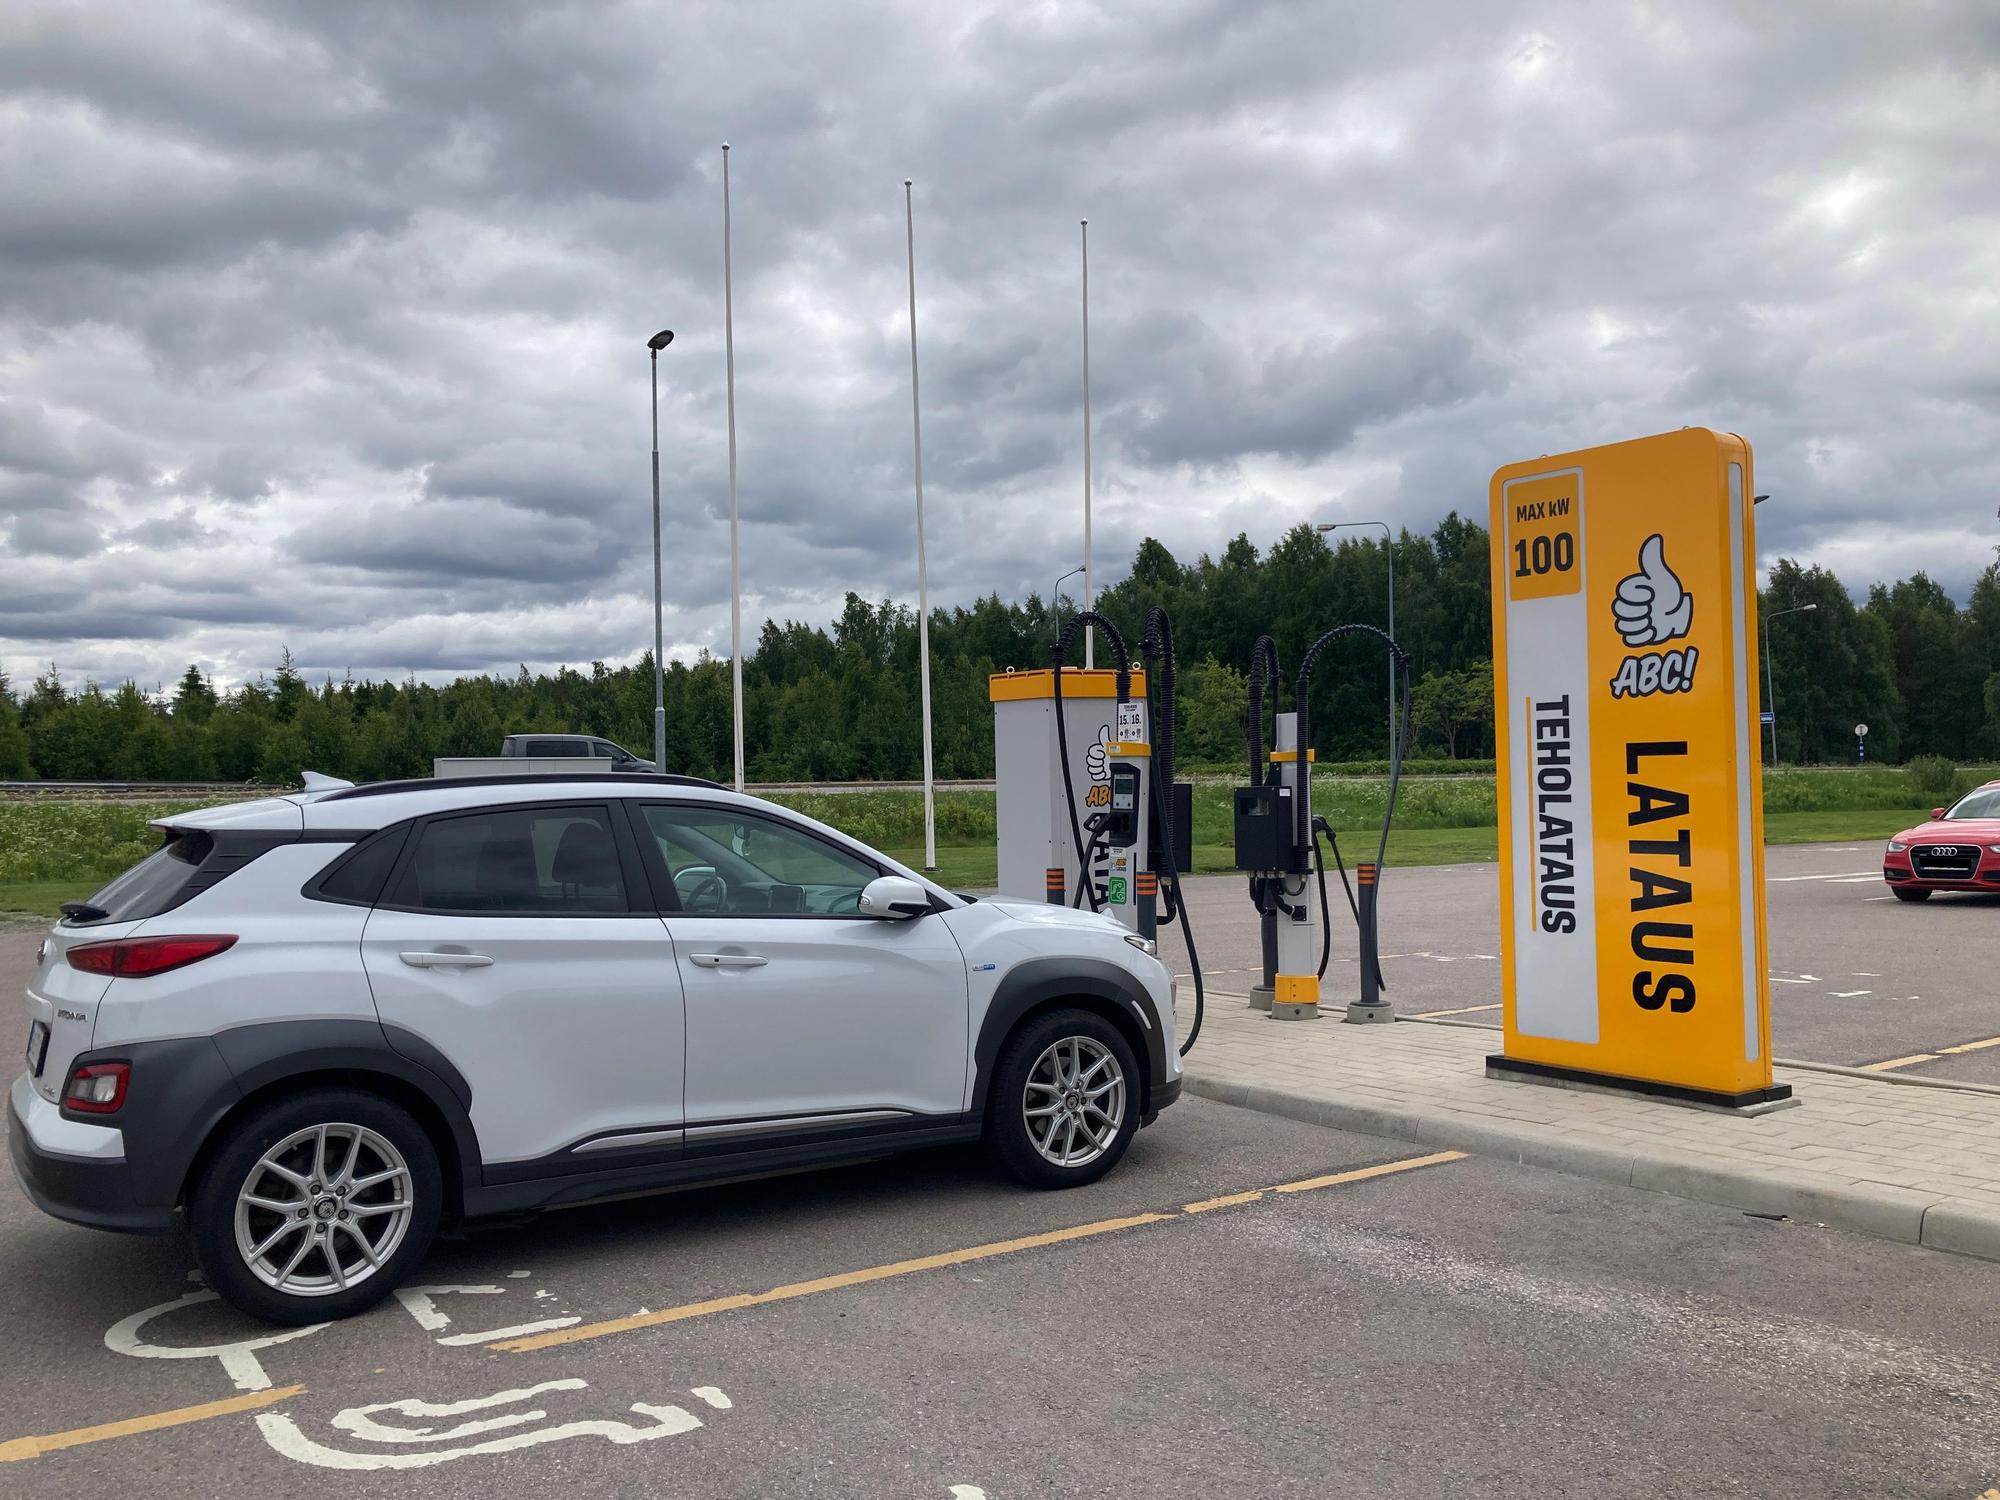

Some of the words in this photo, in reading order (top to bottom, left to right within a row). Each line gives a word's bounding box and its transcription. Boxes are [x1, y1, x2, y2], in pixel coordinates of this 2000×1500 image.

[1516, 502, 1546, 522] MAX
[1549, 498, 1570, 517] kW
[1514, 532, 1574, 577] 100
[1609, 646, 1699, 699] ABC!
[1085, 784, 1111, 807] AB
[1536, 694, 1576, 934] TEHOLATAUS
[1625, 741, 1696, 1013] LATAUS
